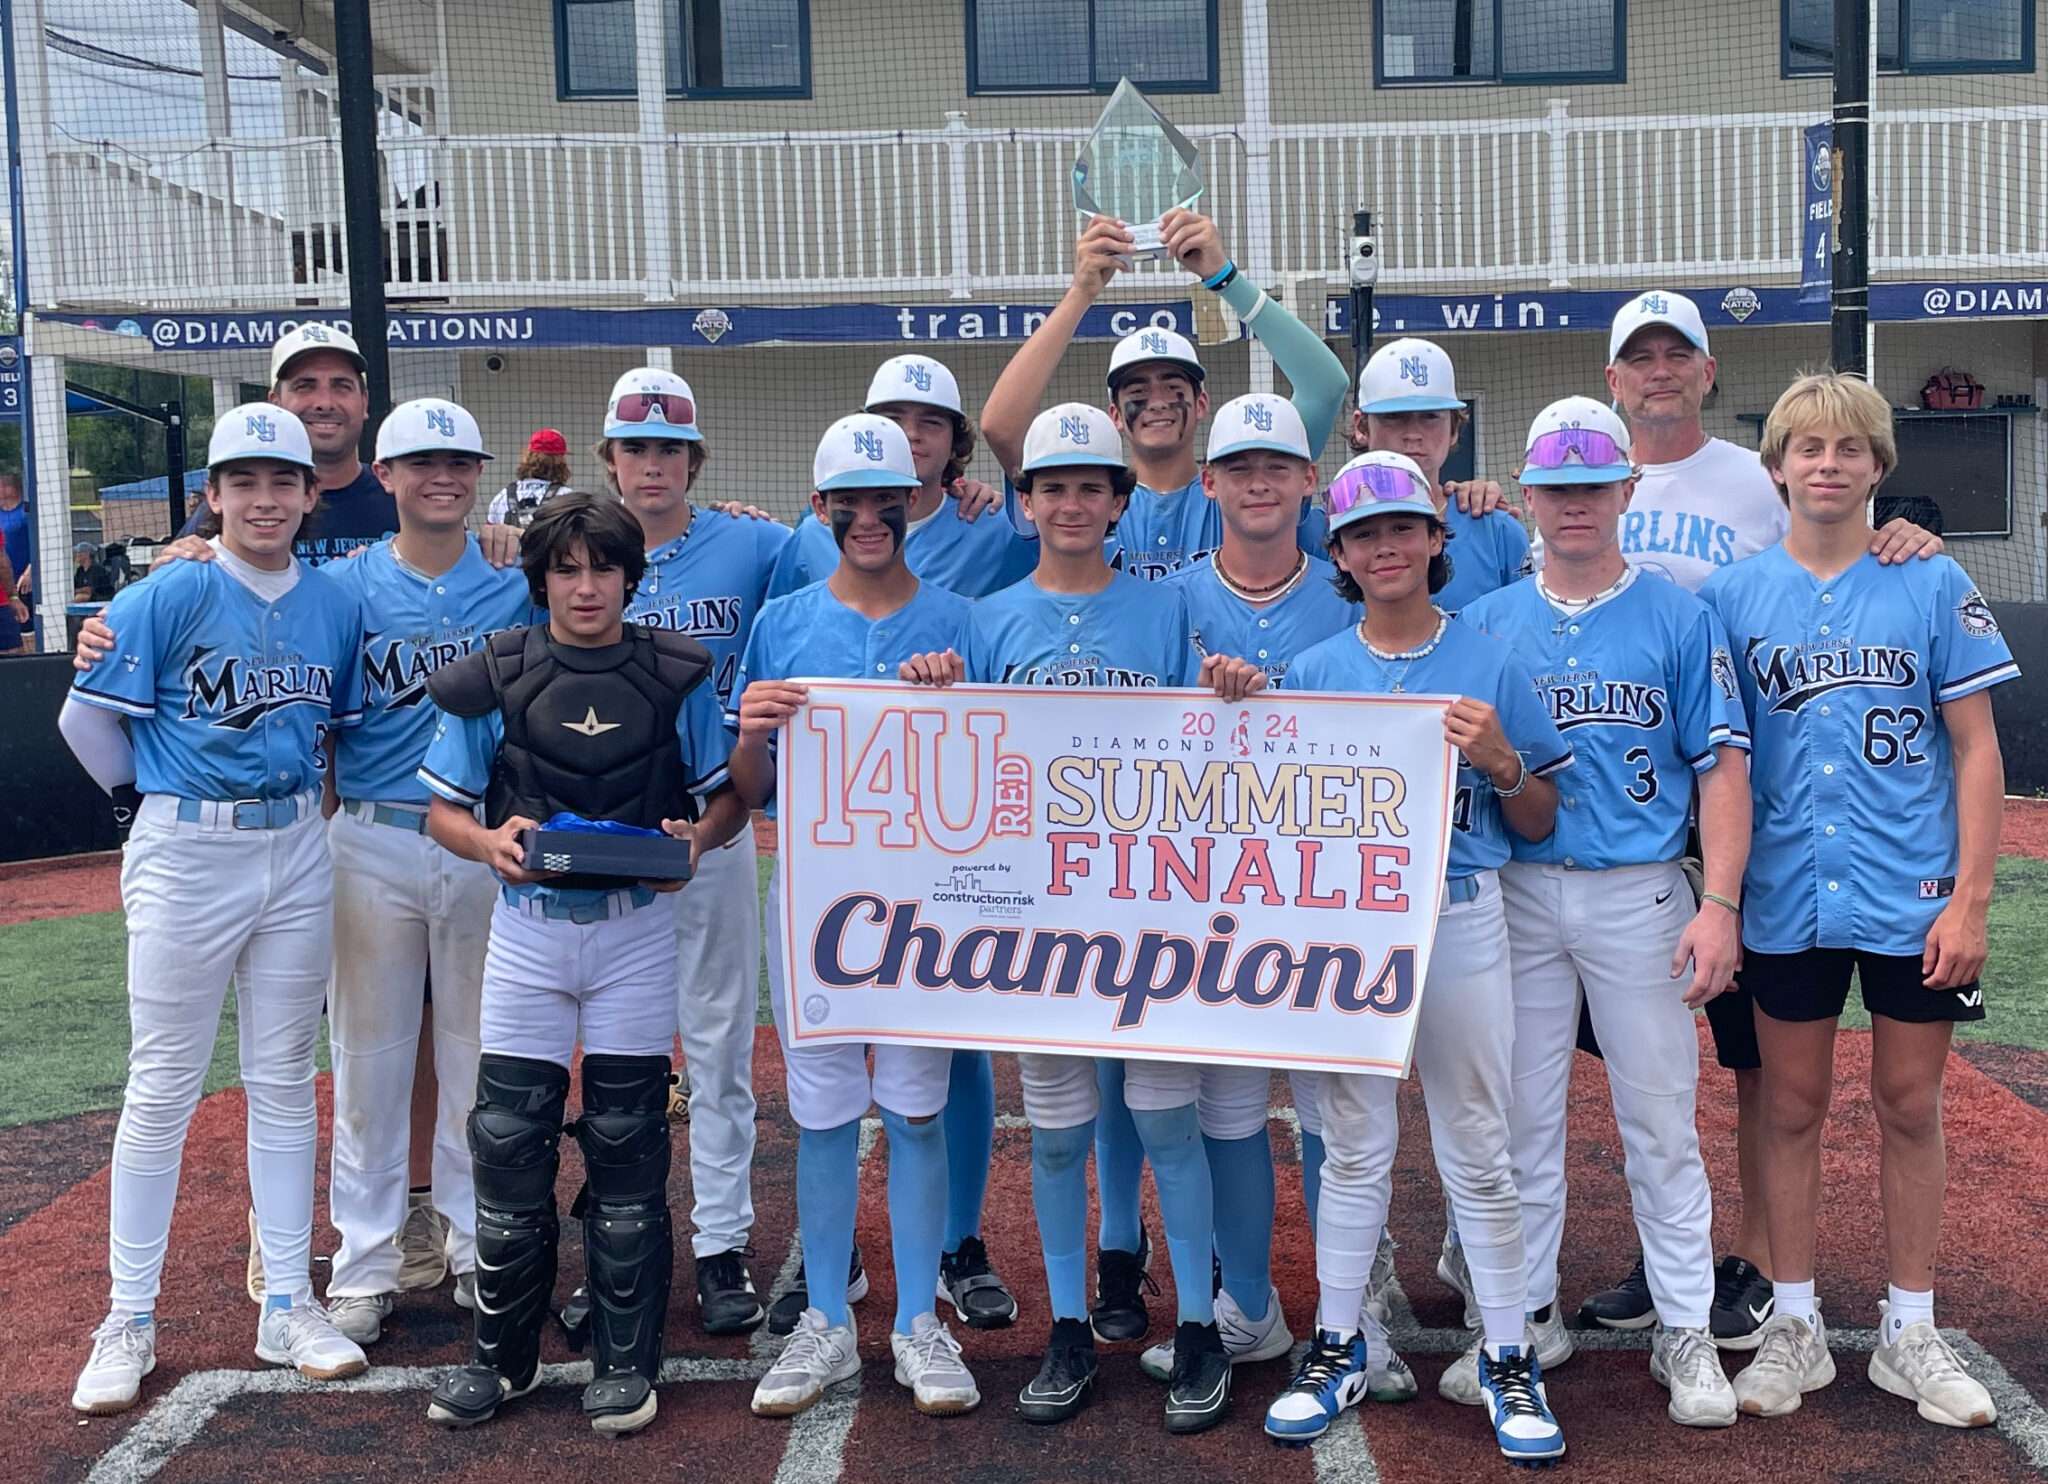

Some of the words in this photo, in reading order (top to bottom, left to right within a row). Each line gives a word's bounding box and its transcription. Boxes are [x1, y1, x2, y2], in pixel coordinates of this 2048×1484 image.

[1815, 232, 1827, 268] 4
[1442, 294, 1569, 329] win.
[1923, 287, 2048, 315] @DIAM
[4, 388, 18, 407] 3
[297, 539, 329, 555] NEW
[1750, 646, 1919, 702] MARLINS
[1181, 712, 1216, 736] 20
[1265, 714, 1299, 738] 24
[1862, 705, 1929, 767] 62
[1072, 736, 1214, 752] DIAMOND
[1264, 741, 1381, 757] NATION
[808, 705, 1006, 855] 14U
[1623, 746, 1659, 805] 3
[994, 755, 1032, 837] RED
[1048, 756, 1410, 838] SUMMER
[952, 863, 996, 873] powered
[998, 863, 1011, 873] by
[1048, 832, 1410, 912] FINALE
[932, 892, 1011, 905] construction
[1013, 894, 1035, 906] risk
[979, 904, 1023, 915] partners
[811, 891, 1418, 1031] Champions
